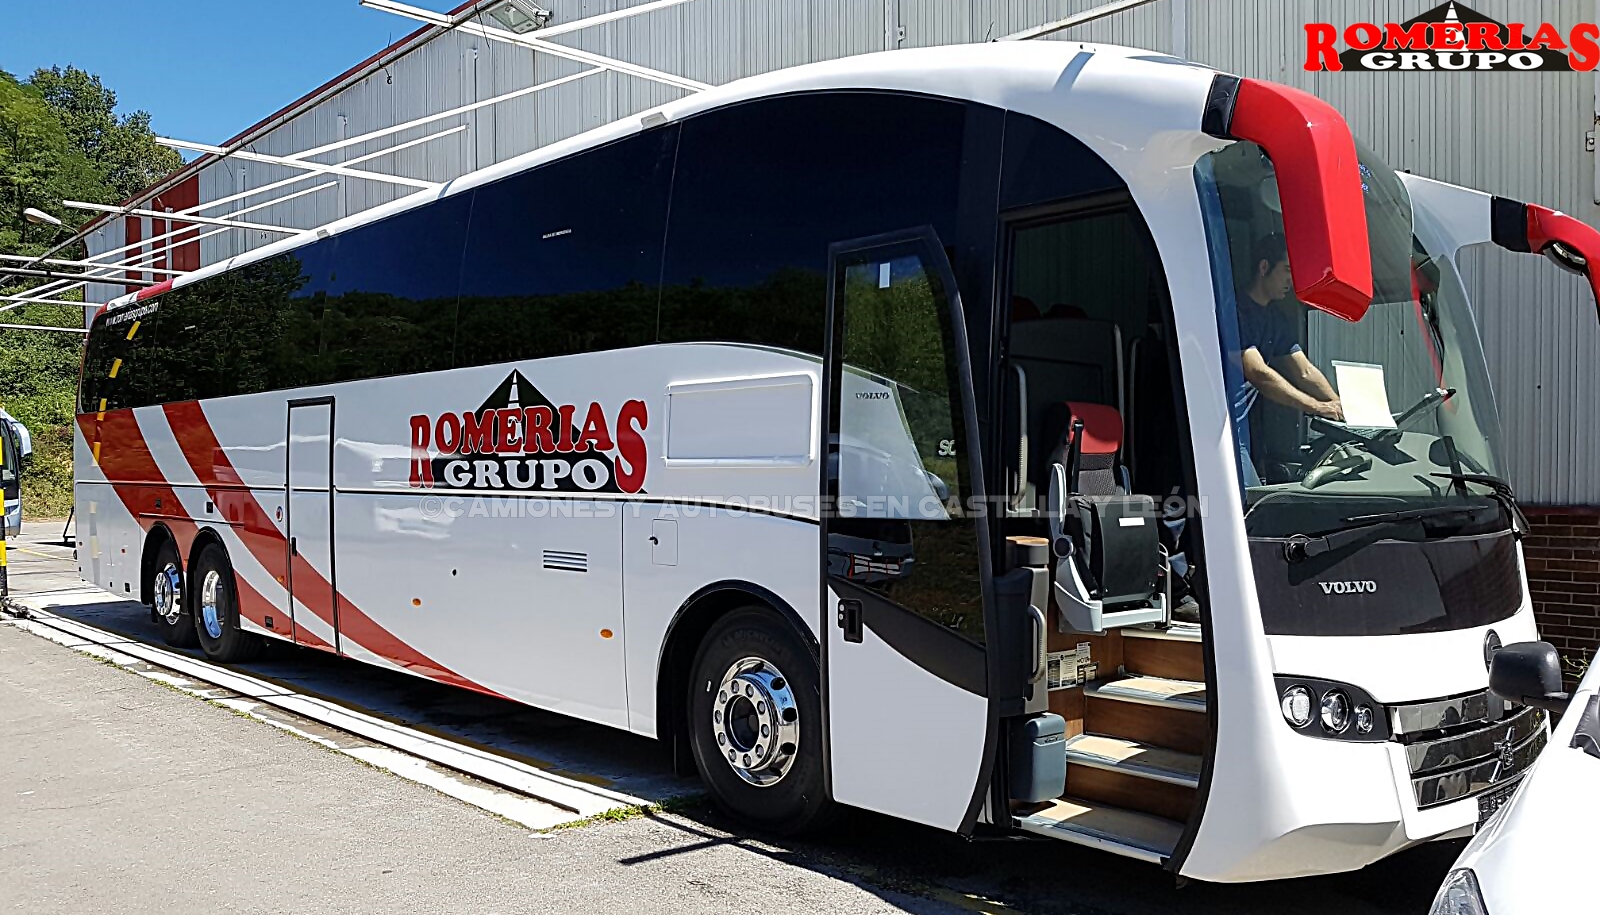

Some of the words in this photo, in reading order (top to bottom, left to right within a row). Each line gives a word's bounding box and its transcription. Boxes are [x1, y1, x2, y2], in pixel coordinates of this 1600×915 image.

[409, 399, 648, 494] ROMERIAS
[443, 459, 609, 490] GRUPO
[1318, 580, 1377, 595] VOLVO
